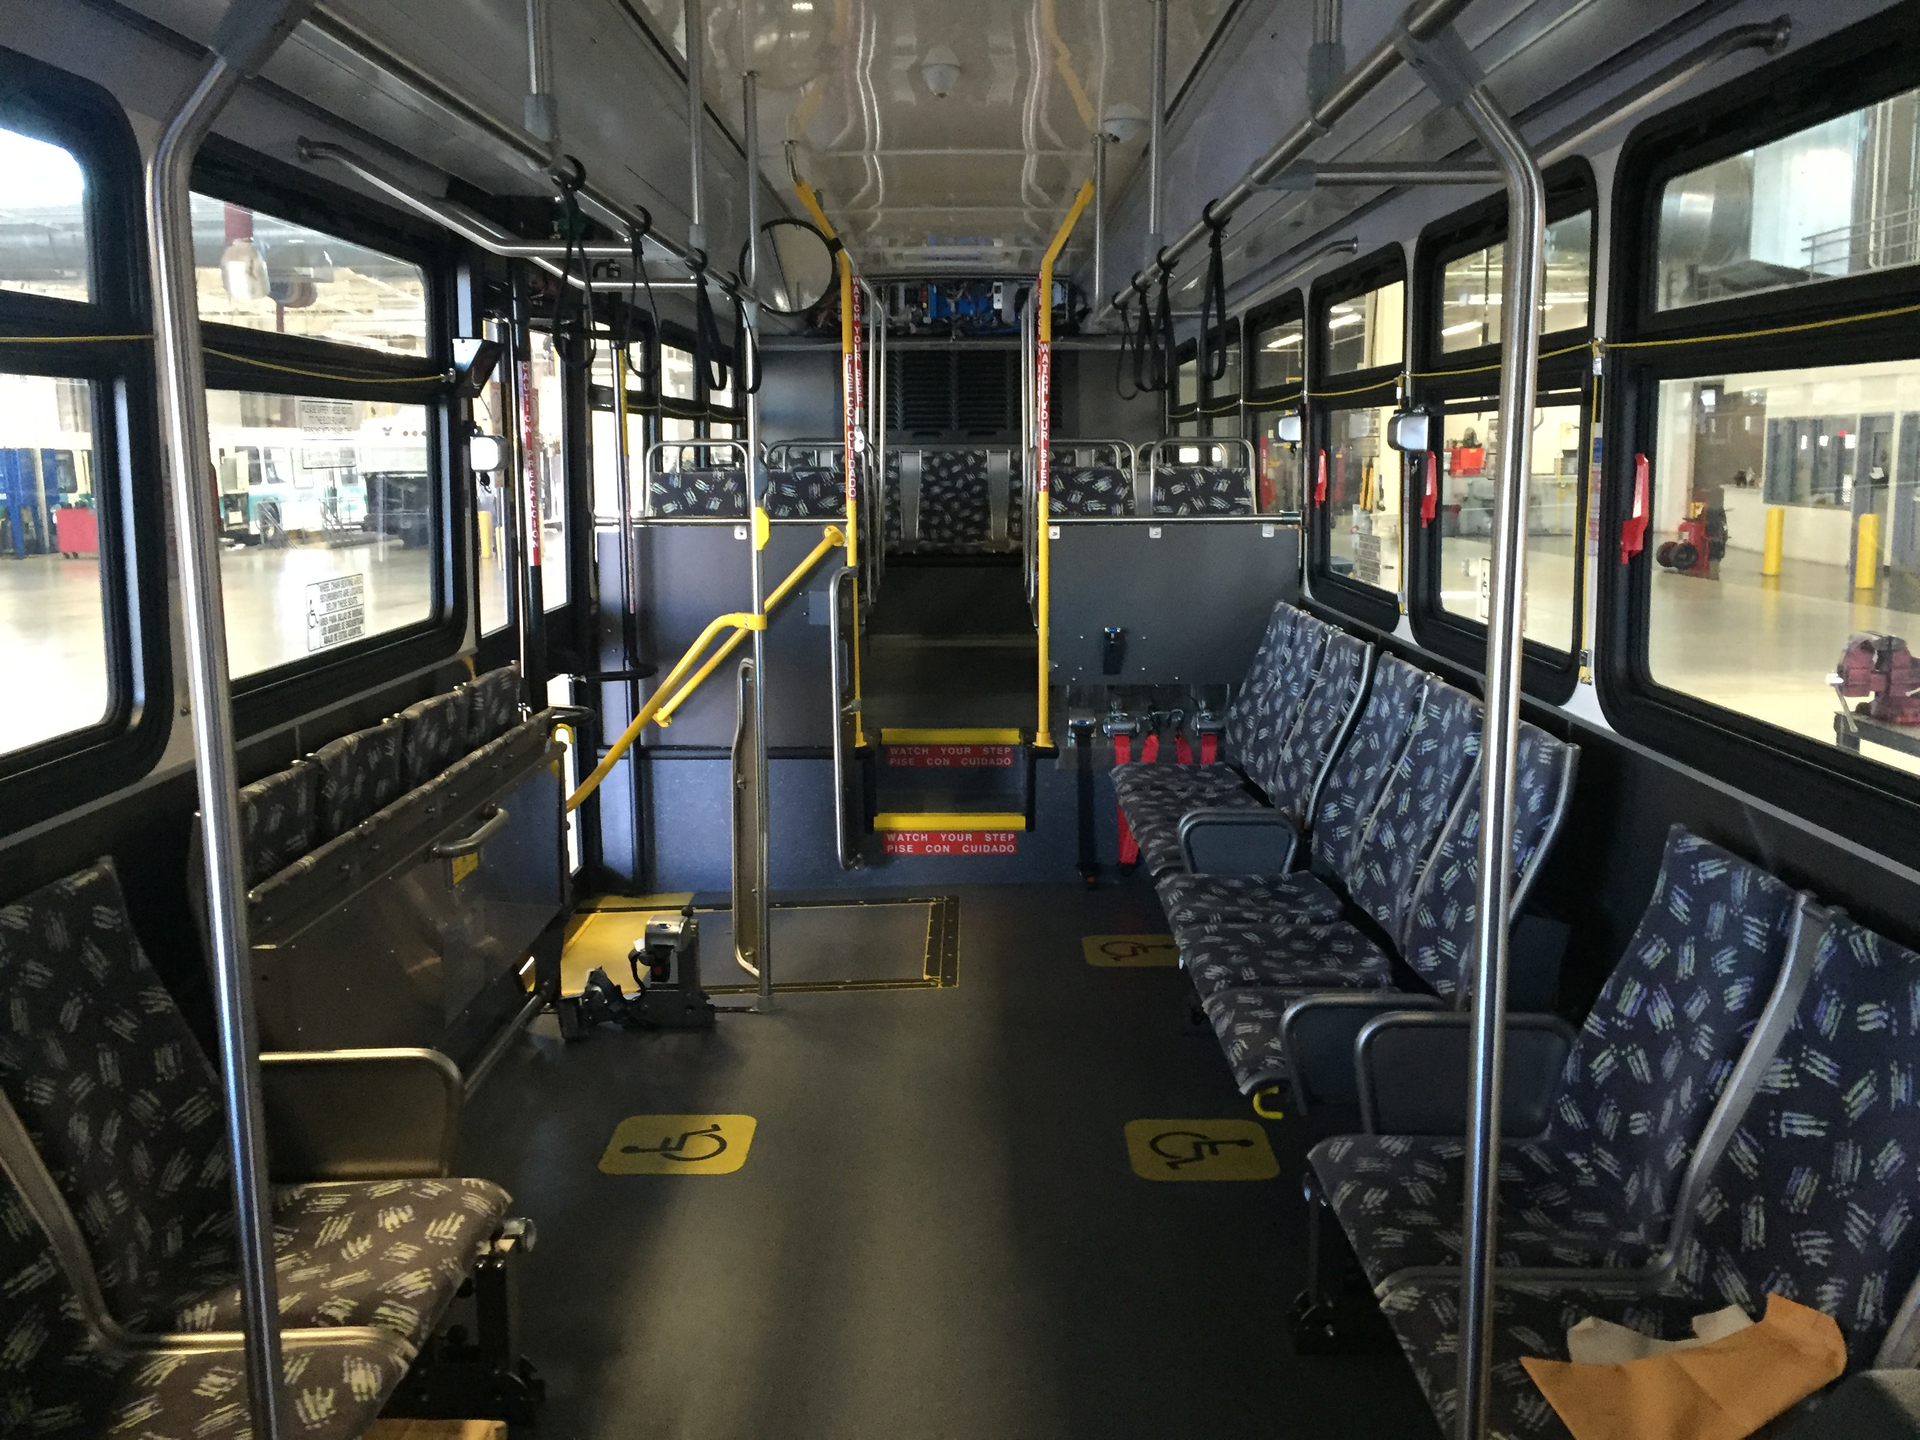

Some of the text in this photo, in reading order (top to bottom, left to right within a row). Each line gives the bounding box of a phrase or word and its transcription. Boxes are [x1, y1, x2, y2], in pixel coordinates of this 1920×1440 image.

[852, 276, 860, 321] WATCH
[853, 326, 861, 361] YOUR
[522, 362, 532, 433] CAUTION
[845, 353, 857, 499] PISE CON CUIDADO
[1040, 343, 1050, 490] WATCH YOUR STEP
[889, 747, 1011, 755] WATCH YOUR STEP
[889, 757, 1011, 766] PISE CON CUIDADO
[886, 833, 1015, 842] WATCH YOUR STEP
[886, 844, 1015, 853] PISE CON CUIDADO
